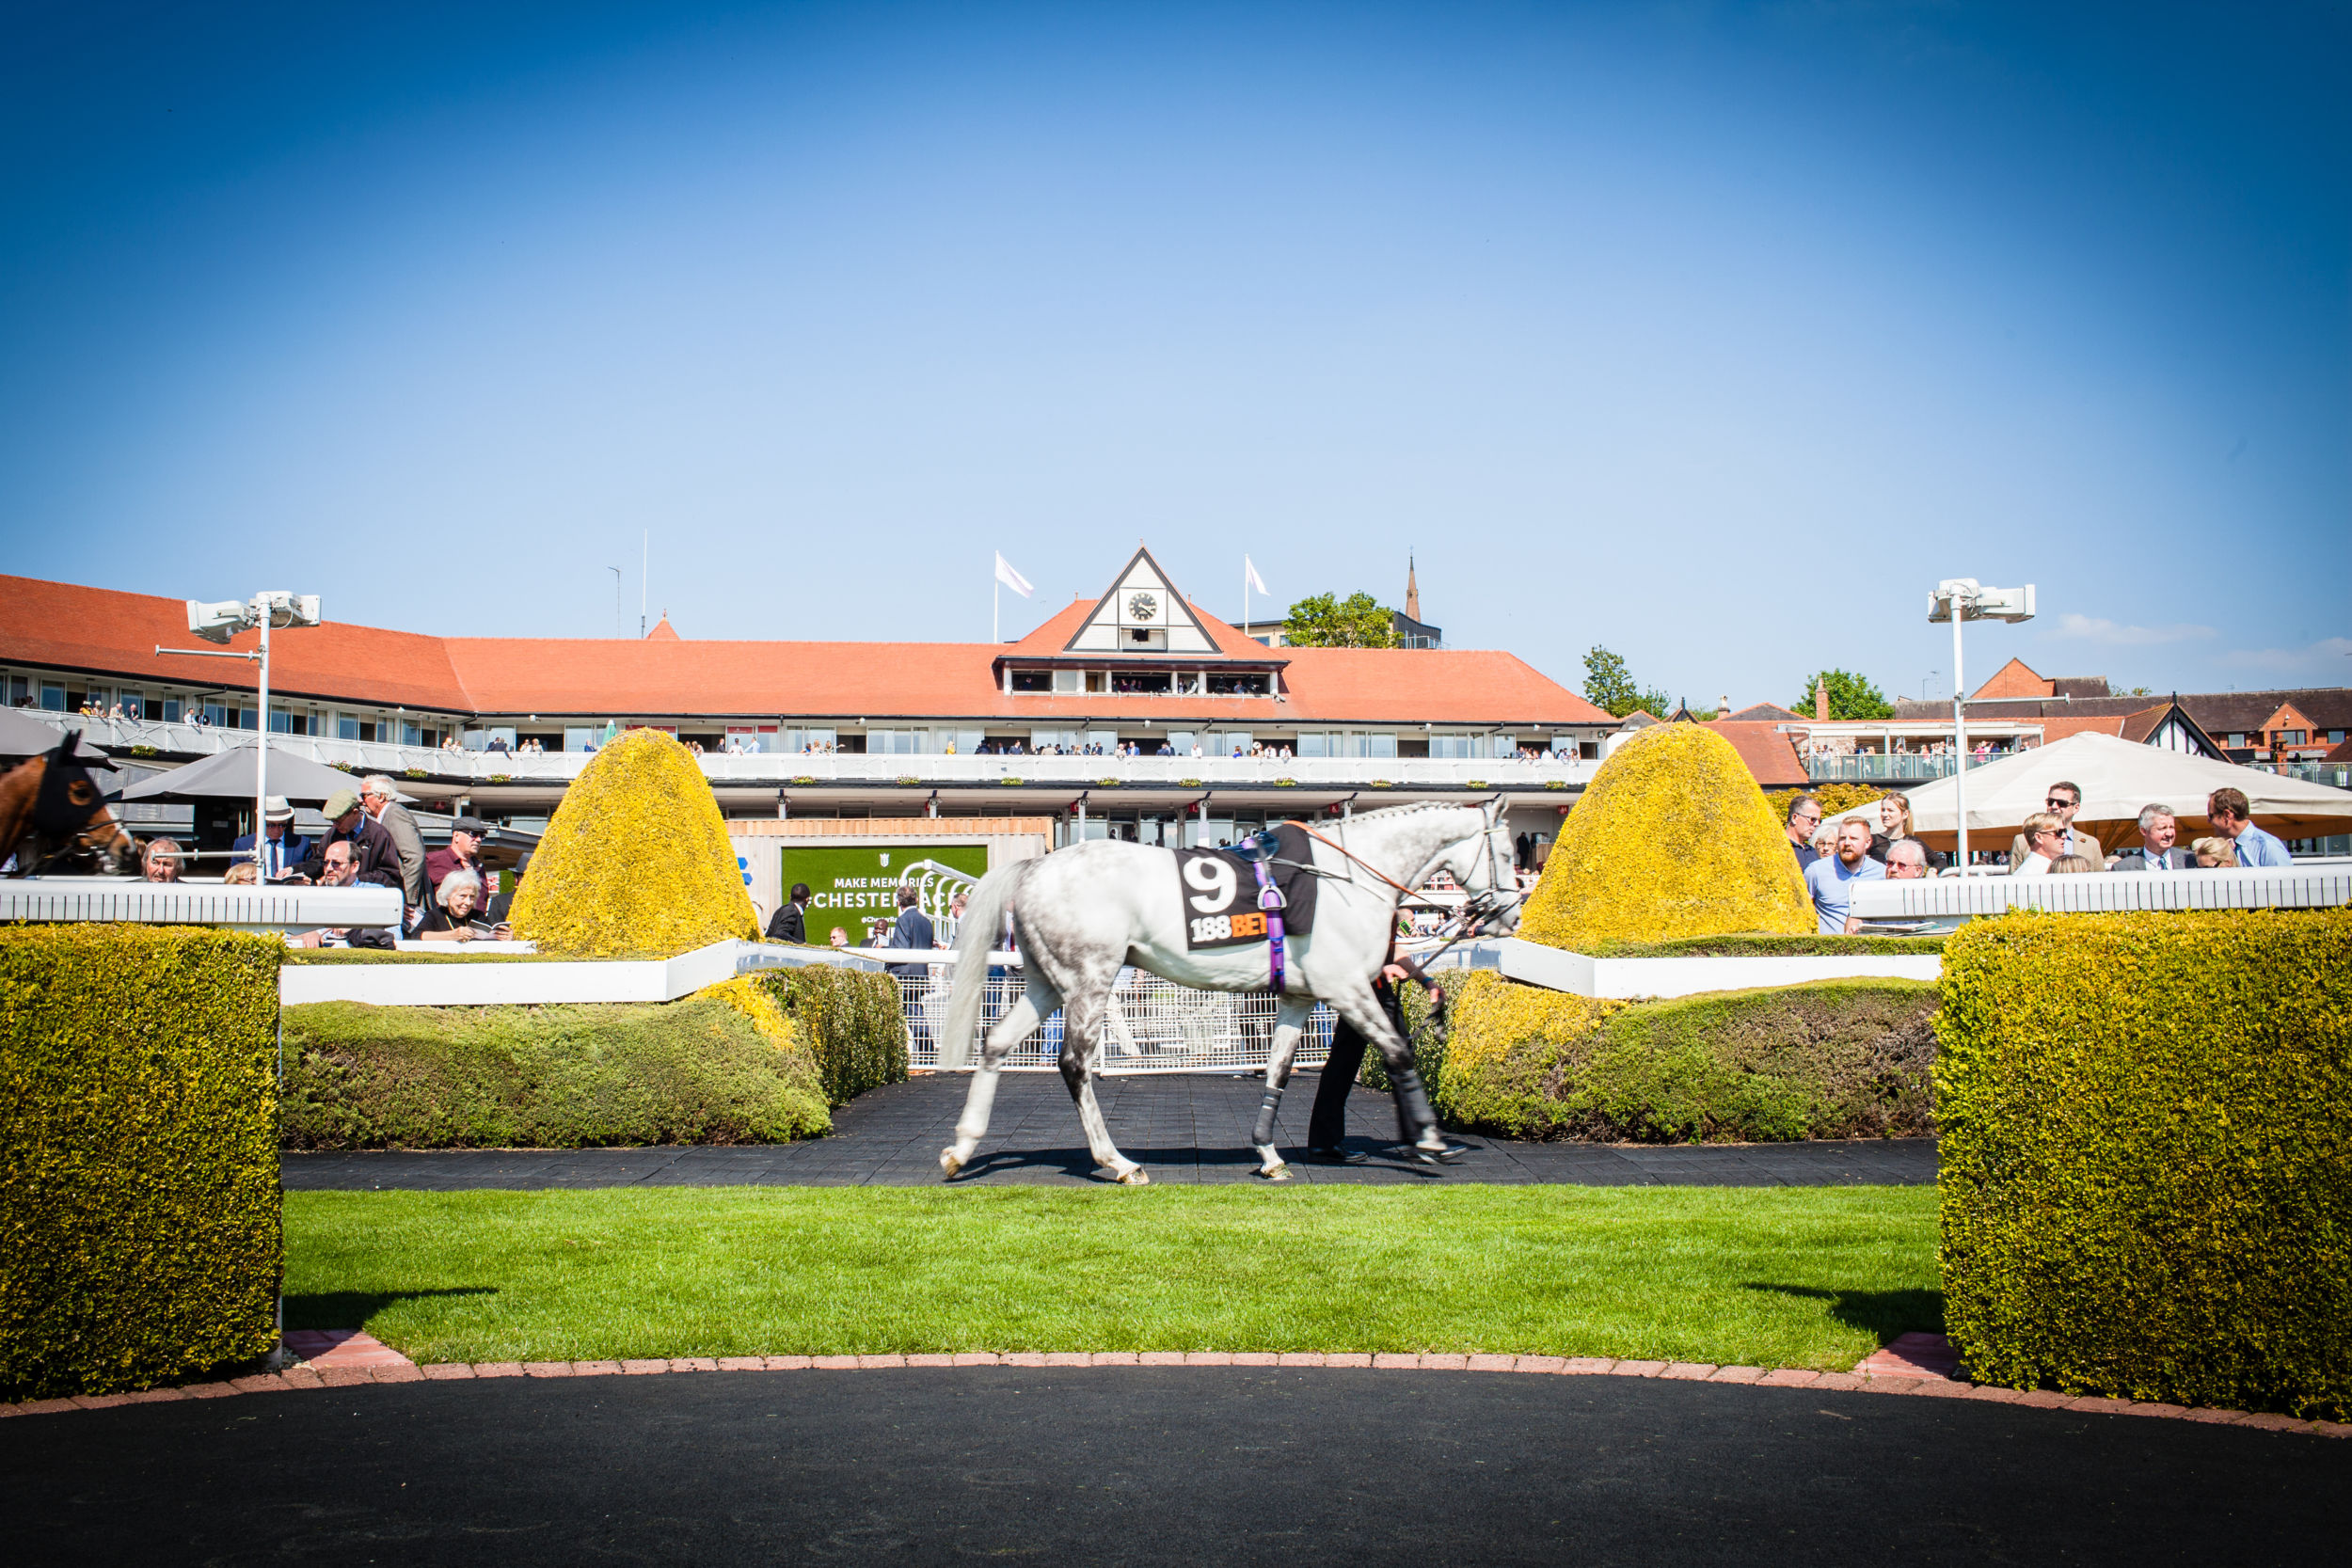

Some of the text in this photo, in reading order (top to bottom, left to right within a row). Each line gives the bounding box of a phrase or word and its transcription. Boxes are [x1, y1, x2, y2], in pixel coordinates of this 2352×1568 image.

[834, 878, 867, 888] MAKE
[1184, 857, 1237, 913] 9
[1190, 912, 1268, 942] 188BET
